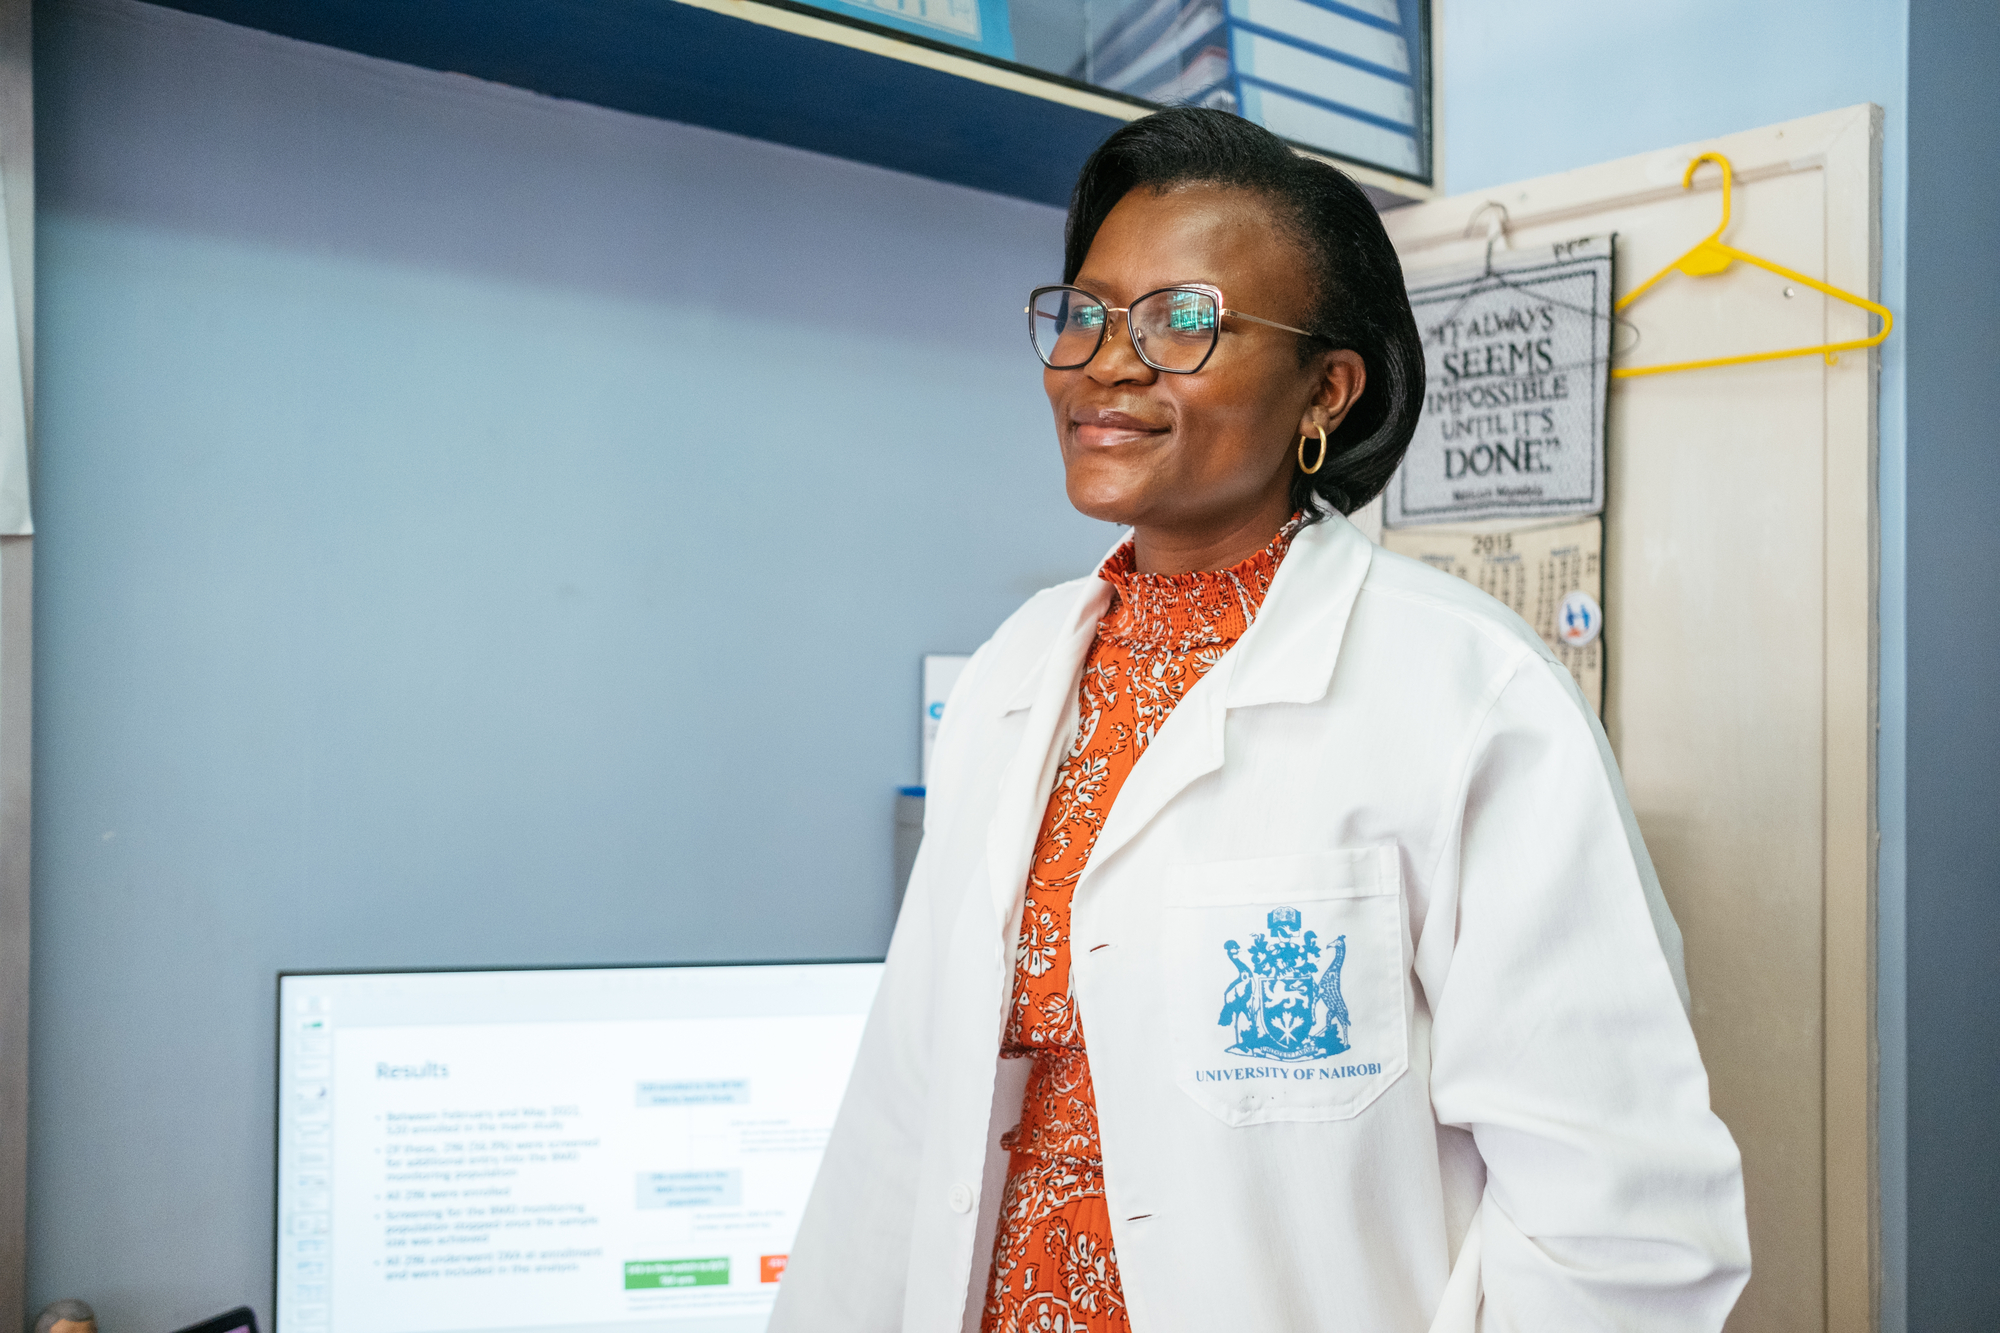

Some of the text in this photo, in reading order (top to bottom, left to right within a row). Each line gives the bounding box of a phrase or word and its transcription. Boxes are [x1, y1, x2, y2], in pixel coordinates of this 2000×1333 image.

[1467, 304, 1554, 338] ALWAYS
[1442, 338, 1554, 386] SEEMS
[1427, 374, 1569, 415] IMPOSSIBLE
[1442, 414, 1507, 441] UNTIL
[376, 1060, 449, 1079] Results
[1196, 1063, 1381, 1082] UNIVERSITY OF NAIROBI
